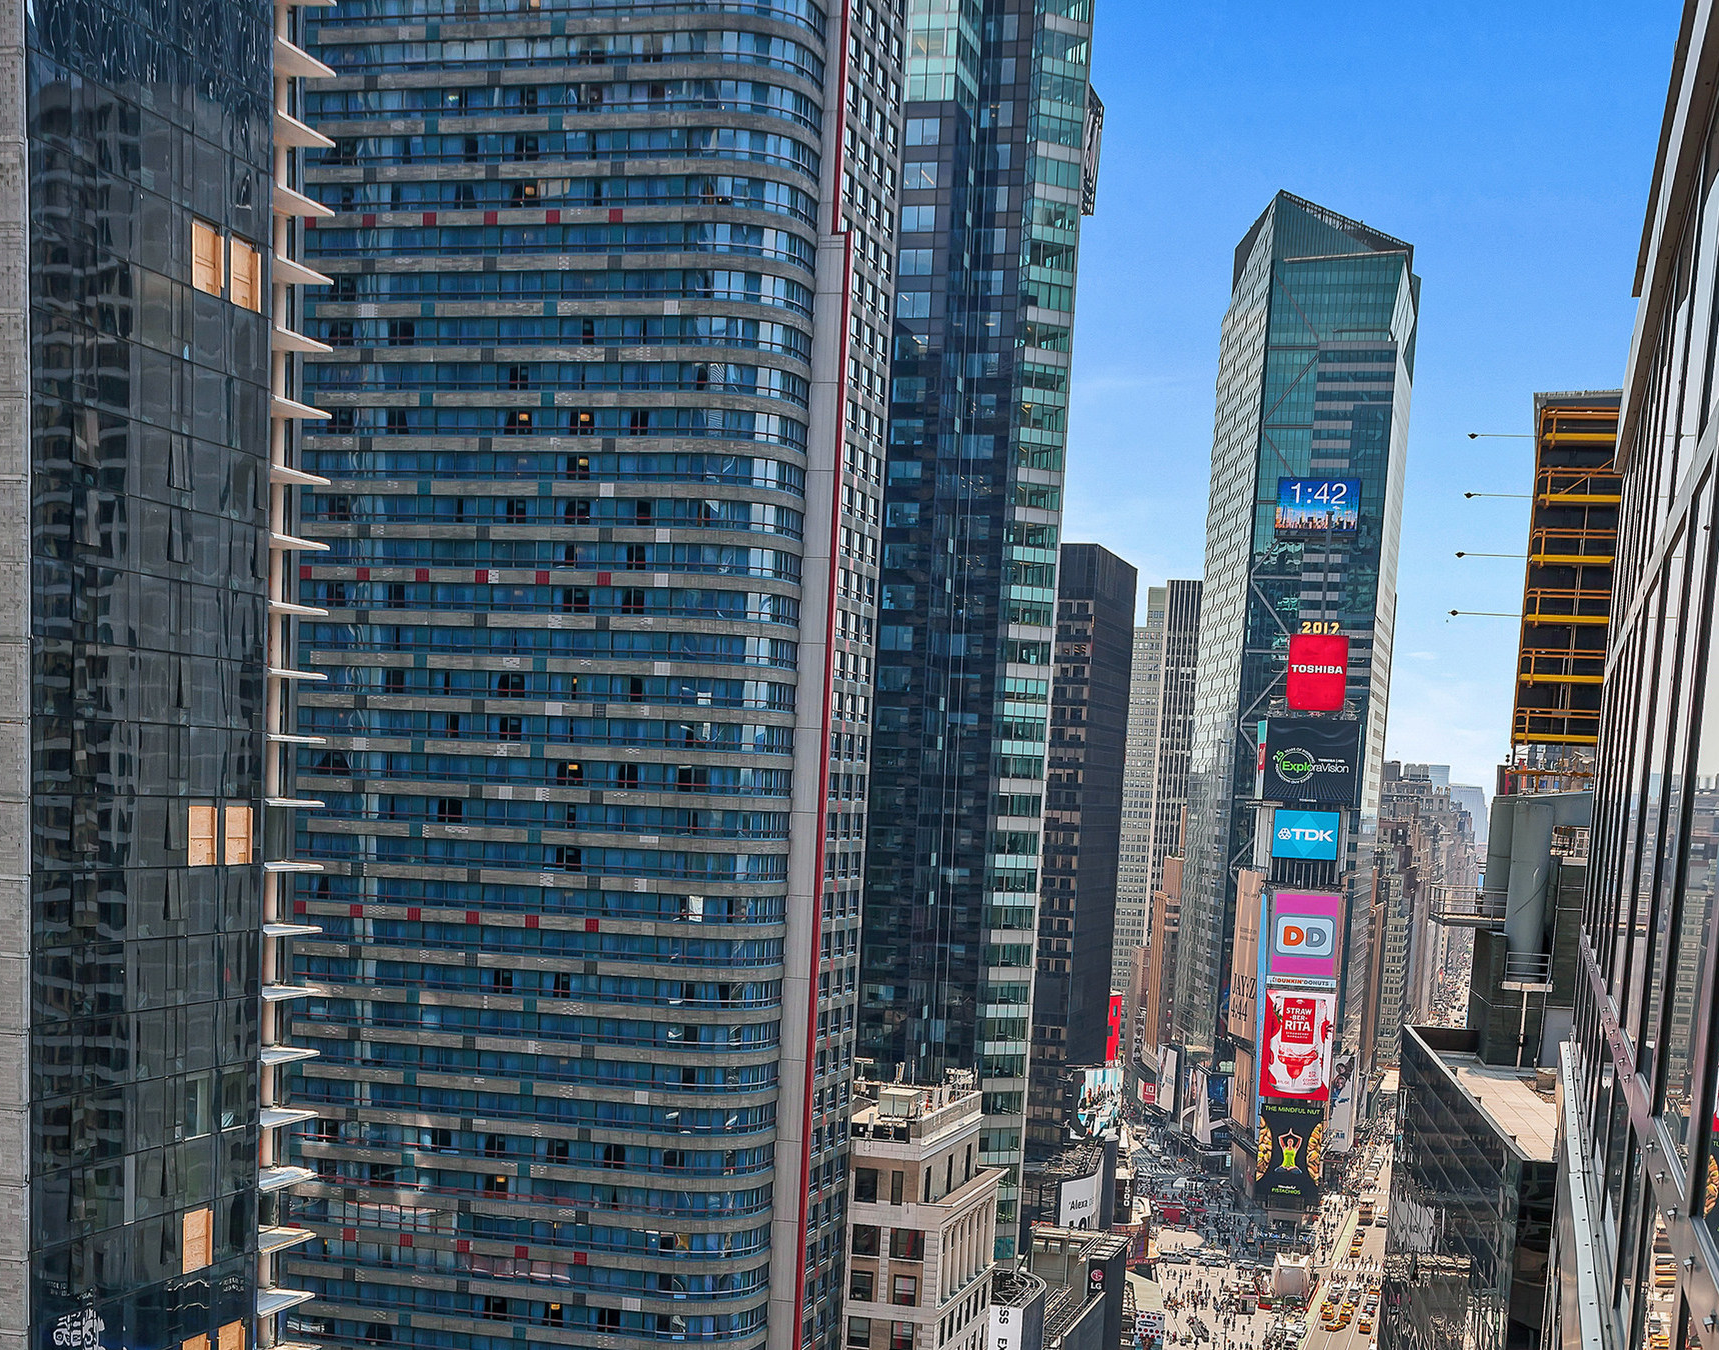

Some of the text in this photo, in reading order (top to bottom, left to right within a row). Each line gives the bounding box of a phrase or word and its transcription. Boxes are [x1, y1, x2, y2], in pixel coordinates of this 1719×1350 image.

[1290, 482, 1348, 504] 1:42
[1301, 621, 1340, 635] 2017
[1291, 664, 1344, 675] TOSHIBA
[1282, 760, 1349, 773] ExploraVision
[1291, 828, 1334, 842] TDK
[1286, 1007, 1312, 1015] STRAW
[1278, 1106, 1306, 1115] MINDFUL
[1271, 1187, 1301, 1195] PISTACHIOS
[1090, 1282, 1102, 1290] LG
